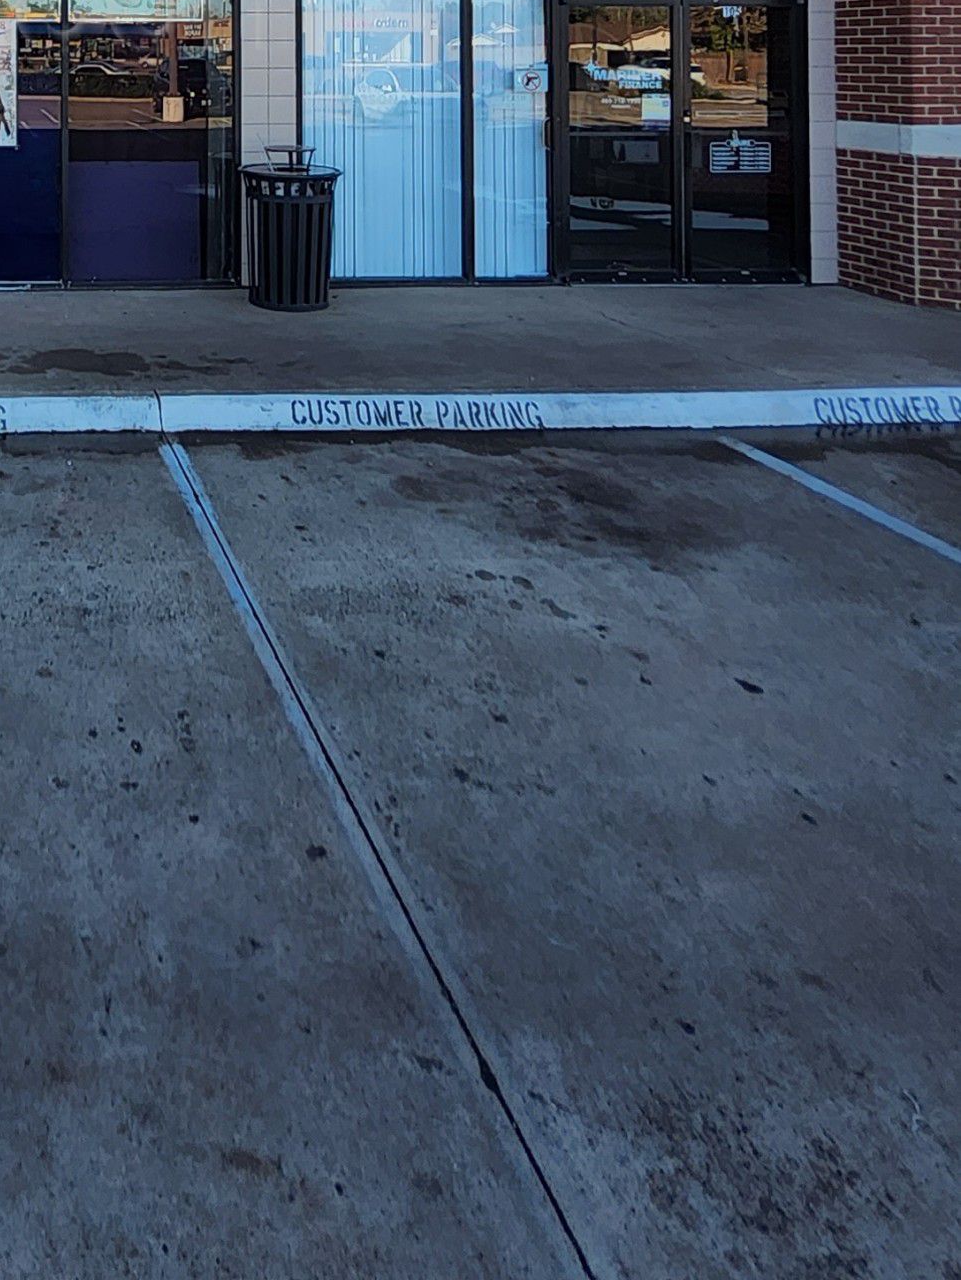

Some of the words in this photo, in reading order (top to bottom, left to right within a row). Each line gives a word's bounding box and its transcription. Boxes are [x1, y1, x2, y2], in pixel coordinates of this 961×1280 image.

[619, 80, 663, 89] FINANCE
[291, 399, 425, 428] CUSTOMER
[436, 400, 542, 430] PARKING
[814, 395, 946, 425] CUSTOMER
